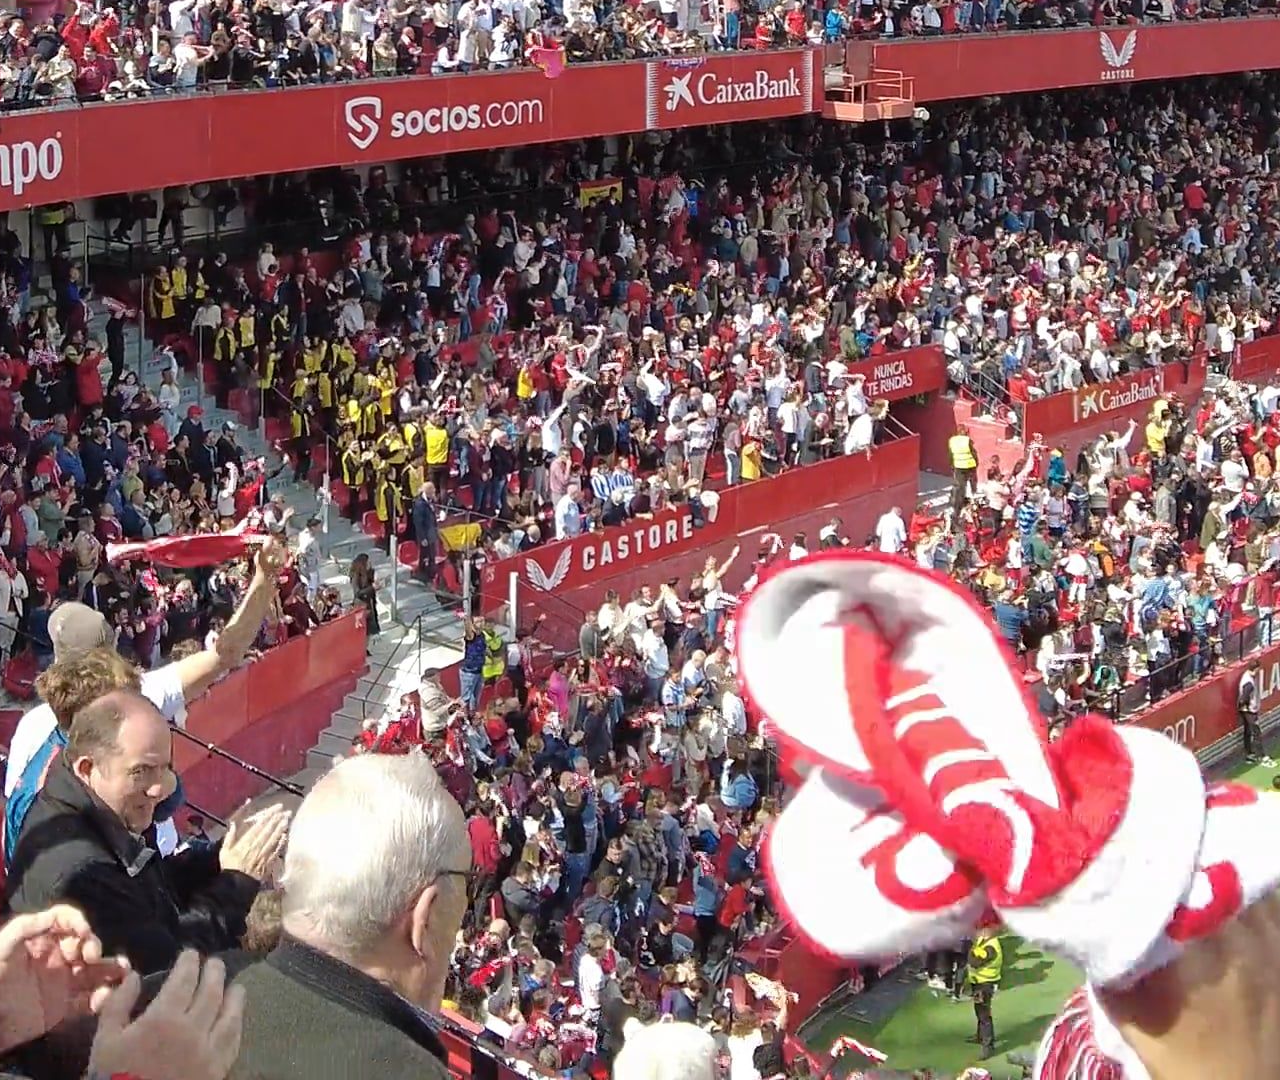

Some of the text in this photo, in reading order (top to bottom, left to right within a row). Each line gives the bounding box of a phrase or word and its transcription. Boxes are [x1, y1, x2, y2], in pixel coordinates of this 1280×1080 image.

[696, 67, 801, 106] CaixaBank
[866, 373, 913, 397] TE RINDAS
[874, 360, 906, 380] NUNCA
[1099, 378, 1158, 412] CaixaBank
[581, 513, 695, 572] CASTORE
